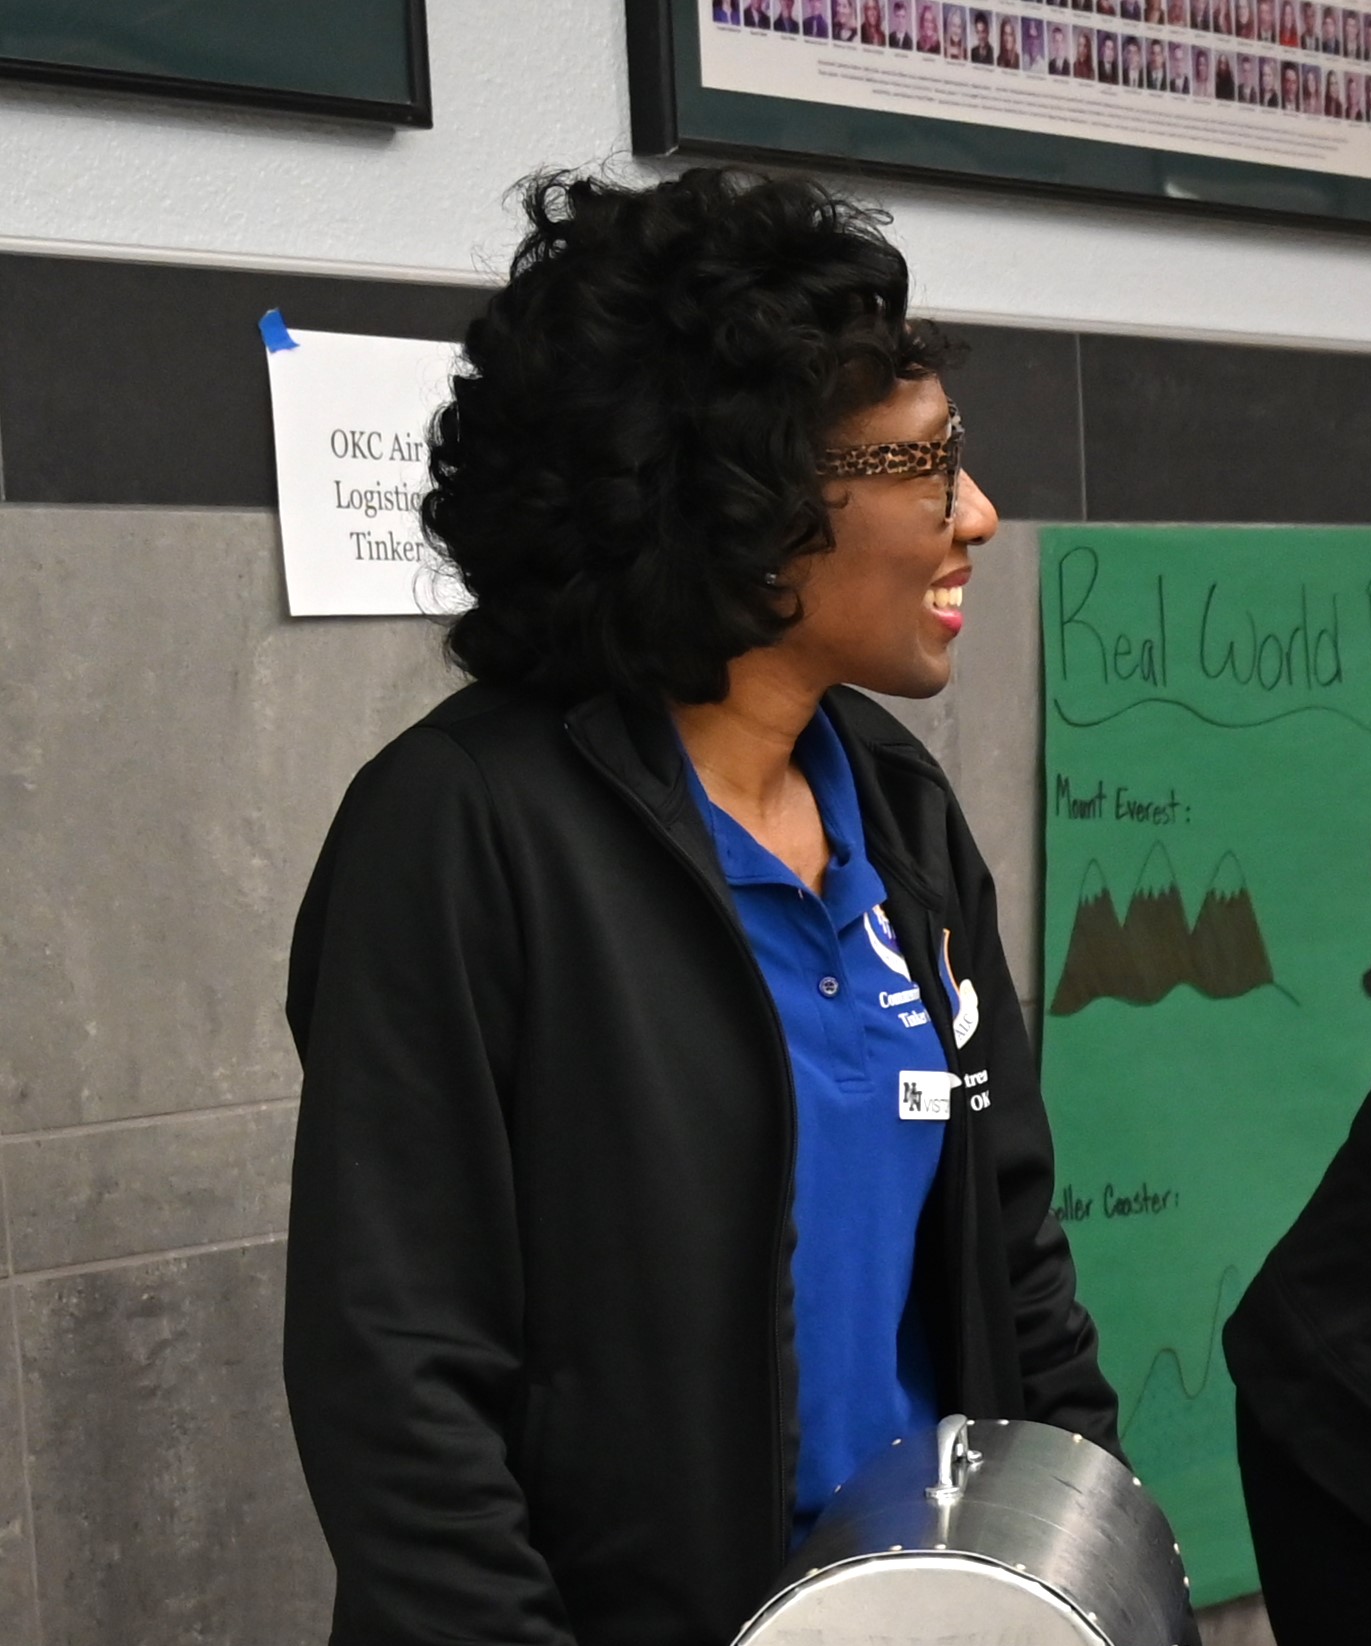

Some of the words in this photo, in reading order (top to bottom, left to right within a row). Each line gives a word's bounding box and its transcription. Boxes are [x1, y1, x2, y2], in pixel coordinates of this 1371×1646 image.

[330, 428, 384, 461] OKC
[389, 432, 423, 462] Air
[333, 480, 421, 519] Logistic
[350, 531, 424, 562] Tinker
[1058, 545, 1167, 687] Real
[1200, 582, 1344, 691] World
[1056, 773, 1107, 820] Mount
[1115, 787, 1191, 826] Everest:
[1050, 1183, 1093, 1222] oller
